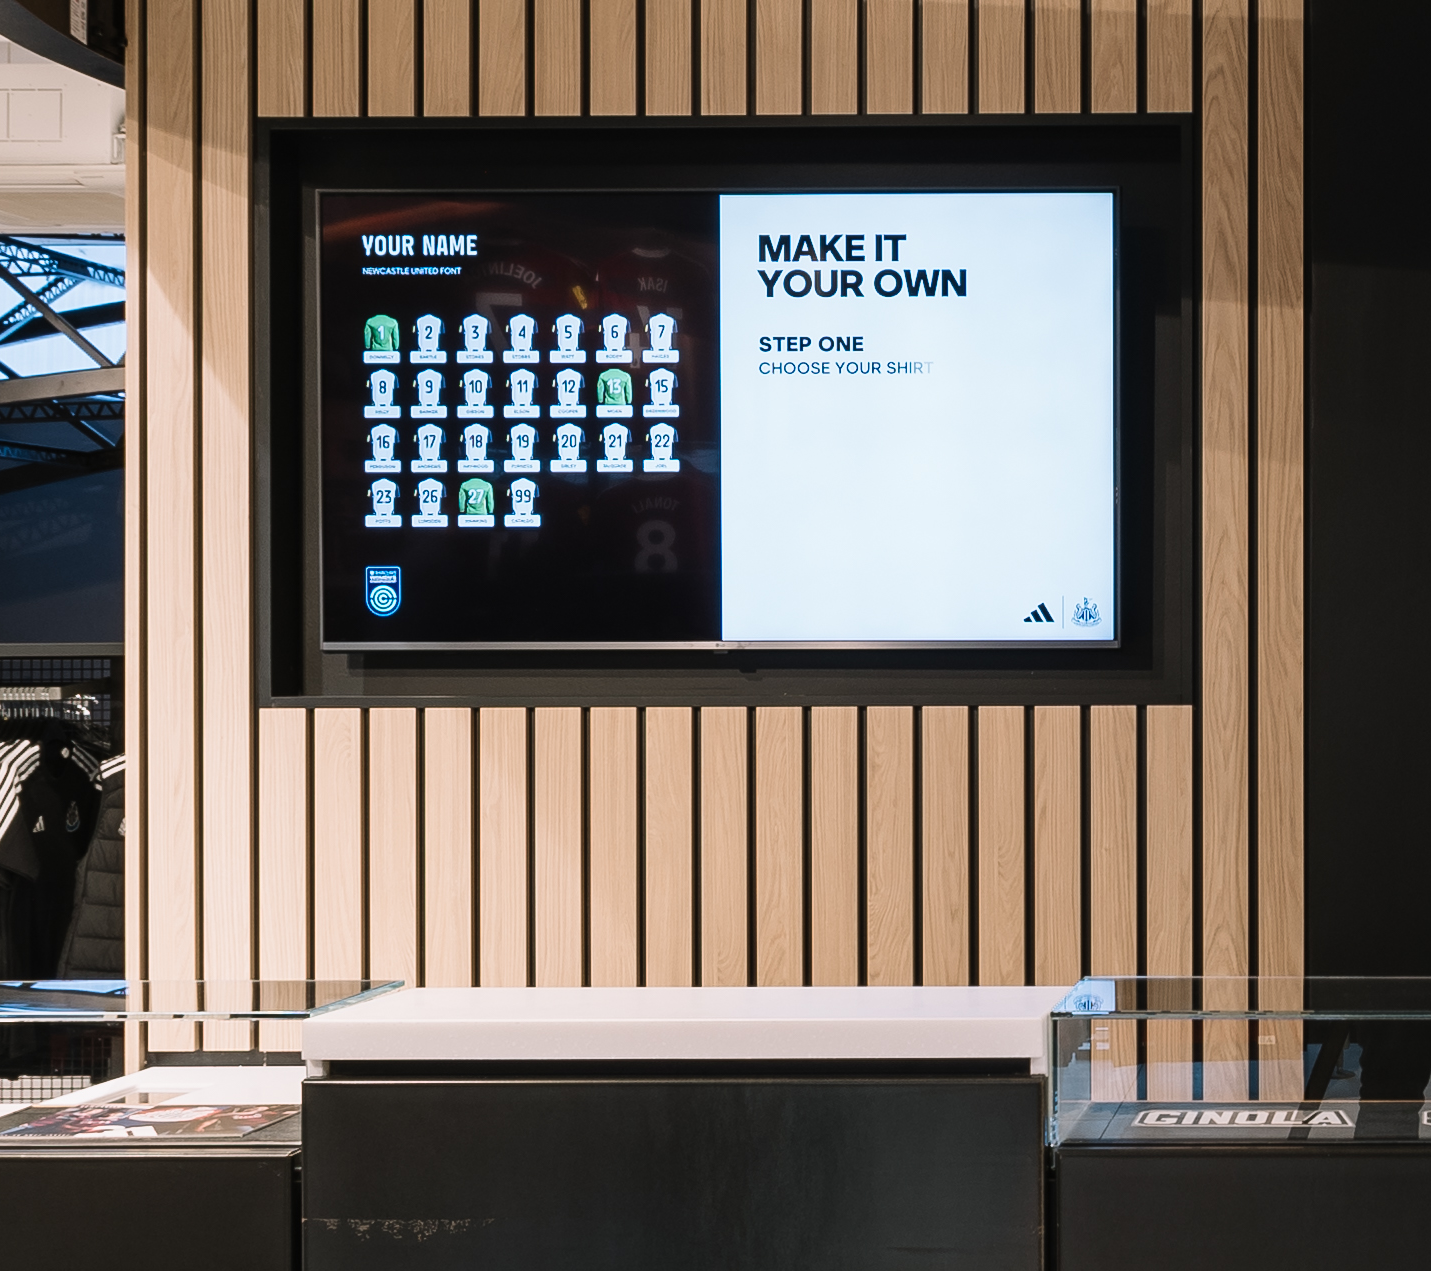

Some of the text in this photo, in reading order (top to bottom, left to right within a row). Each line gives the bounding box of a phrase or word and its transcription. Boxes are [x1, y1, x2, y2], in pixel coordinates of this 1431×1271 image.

[362, 235, 477, 256] YOUR NAME
[759, 234, 906, 262] MAKE IT
[363, 267, 461, 275] NEWCASTLE UNITED FONT
[758, 269, 966, 297] YOUR OWN
[378, 325, 385, 340] 1
[424, 326, 433, 340] 2
[471, 326, 480, 340] 3
[518, 326, 526, 339] 4
[564, 325, 573, 340] 5
[611, 325, 619, 339] 6
[658, 325, 666, 338] 7
[760, 337, 863, 352] STEP ONE
[759, 362, 933, 374] CHOOSE YOUR SHIRT
[378, 381, 387, 395] 8
[425, 380, 433, 394] 9
[468, 380, 483, 394] 10
[516, 380, 528, 393] 11
[561, 380, 576, 394] 12
[607, 379, 622, 394] 13
[654, 379, 669, 393] 15
[376, 435, 391, 449] 16
[423, 435, 437, 449] 17
[469, 435, 483, 449] 18
[516, 435, 530, 449] 19
[561, 435, 577, 449] 20
[608, 435, 622, 448] 21
[654, 434, 670, 448] 22
[376, 490, 392, 504] 23
[422, 490, 438, 504] 26
[468, 489, 484, 504] 27
[515, 490, 532, 504] 99
[1144, 1110, 1345, 1125] GINOLA
